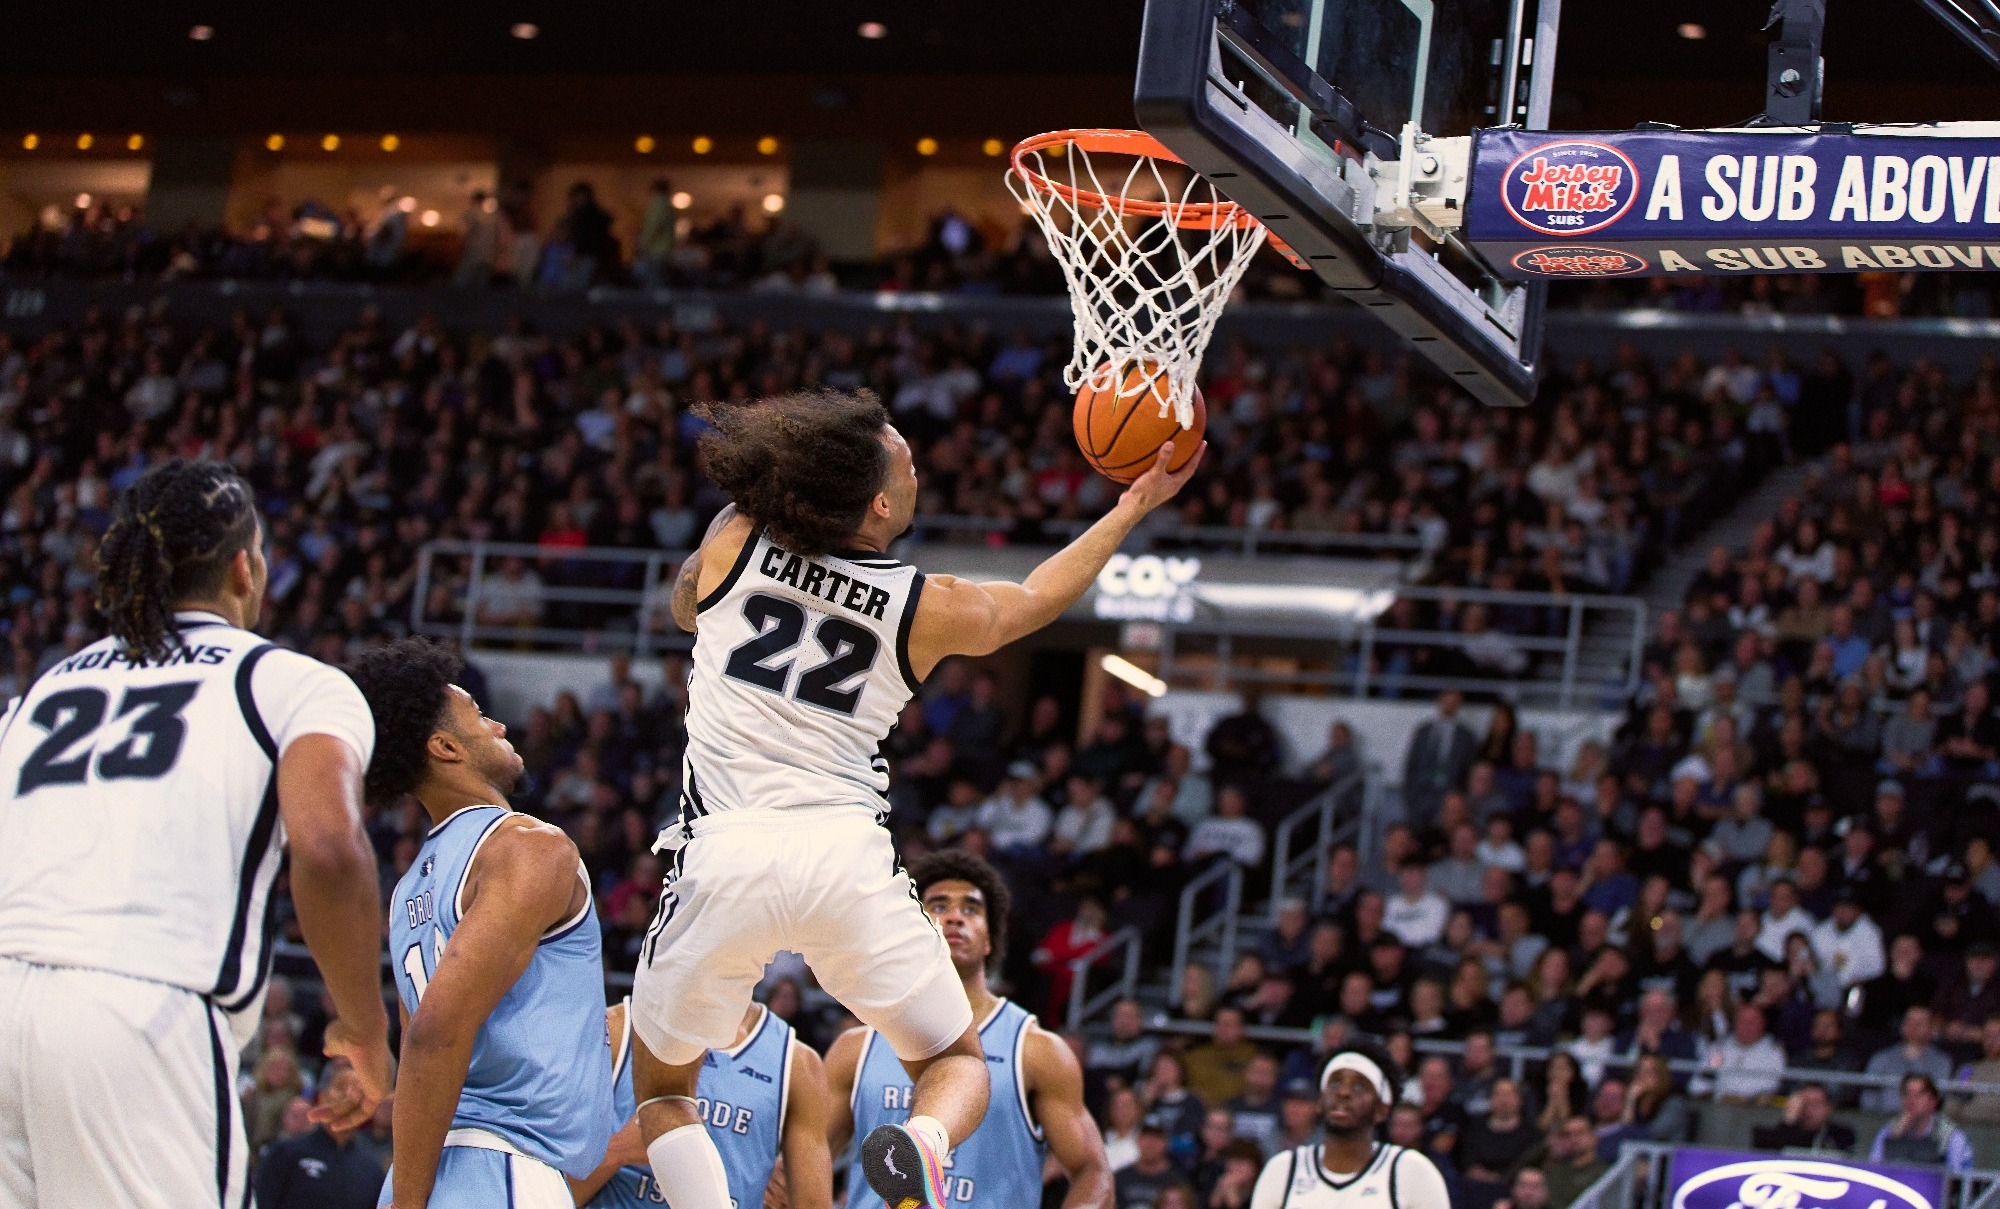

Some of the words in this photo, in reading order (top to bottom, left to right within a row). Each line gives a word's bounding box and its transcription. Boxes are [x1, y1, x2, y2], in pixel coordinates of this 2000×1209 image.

[1521, 157, 1622, 192] Jersey
[1645, 155, 1684, 221] A
[1701, 155, 1818, 222] SUB
[1522, 182, 1617, 212] Mike's
[1547, 215, 1585, 225] SUBS
[1659, 250, 1702, 271] A
[1706, 247, 1827, 270] SUB
[759, 546, 891, 621] CARTER
[720, 590, 882, 719] 22
[14, 679, 205, 799] 23
[406, 890, 434, 930] BRO
